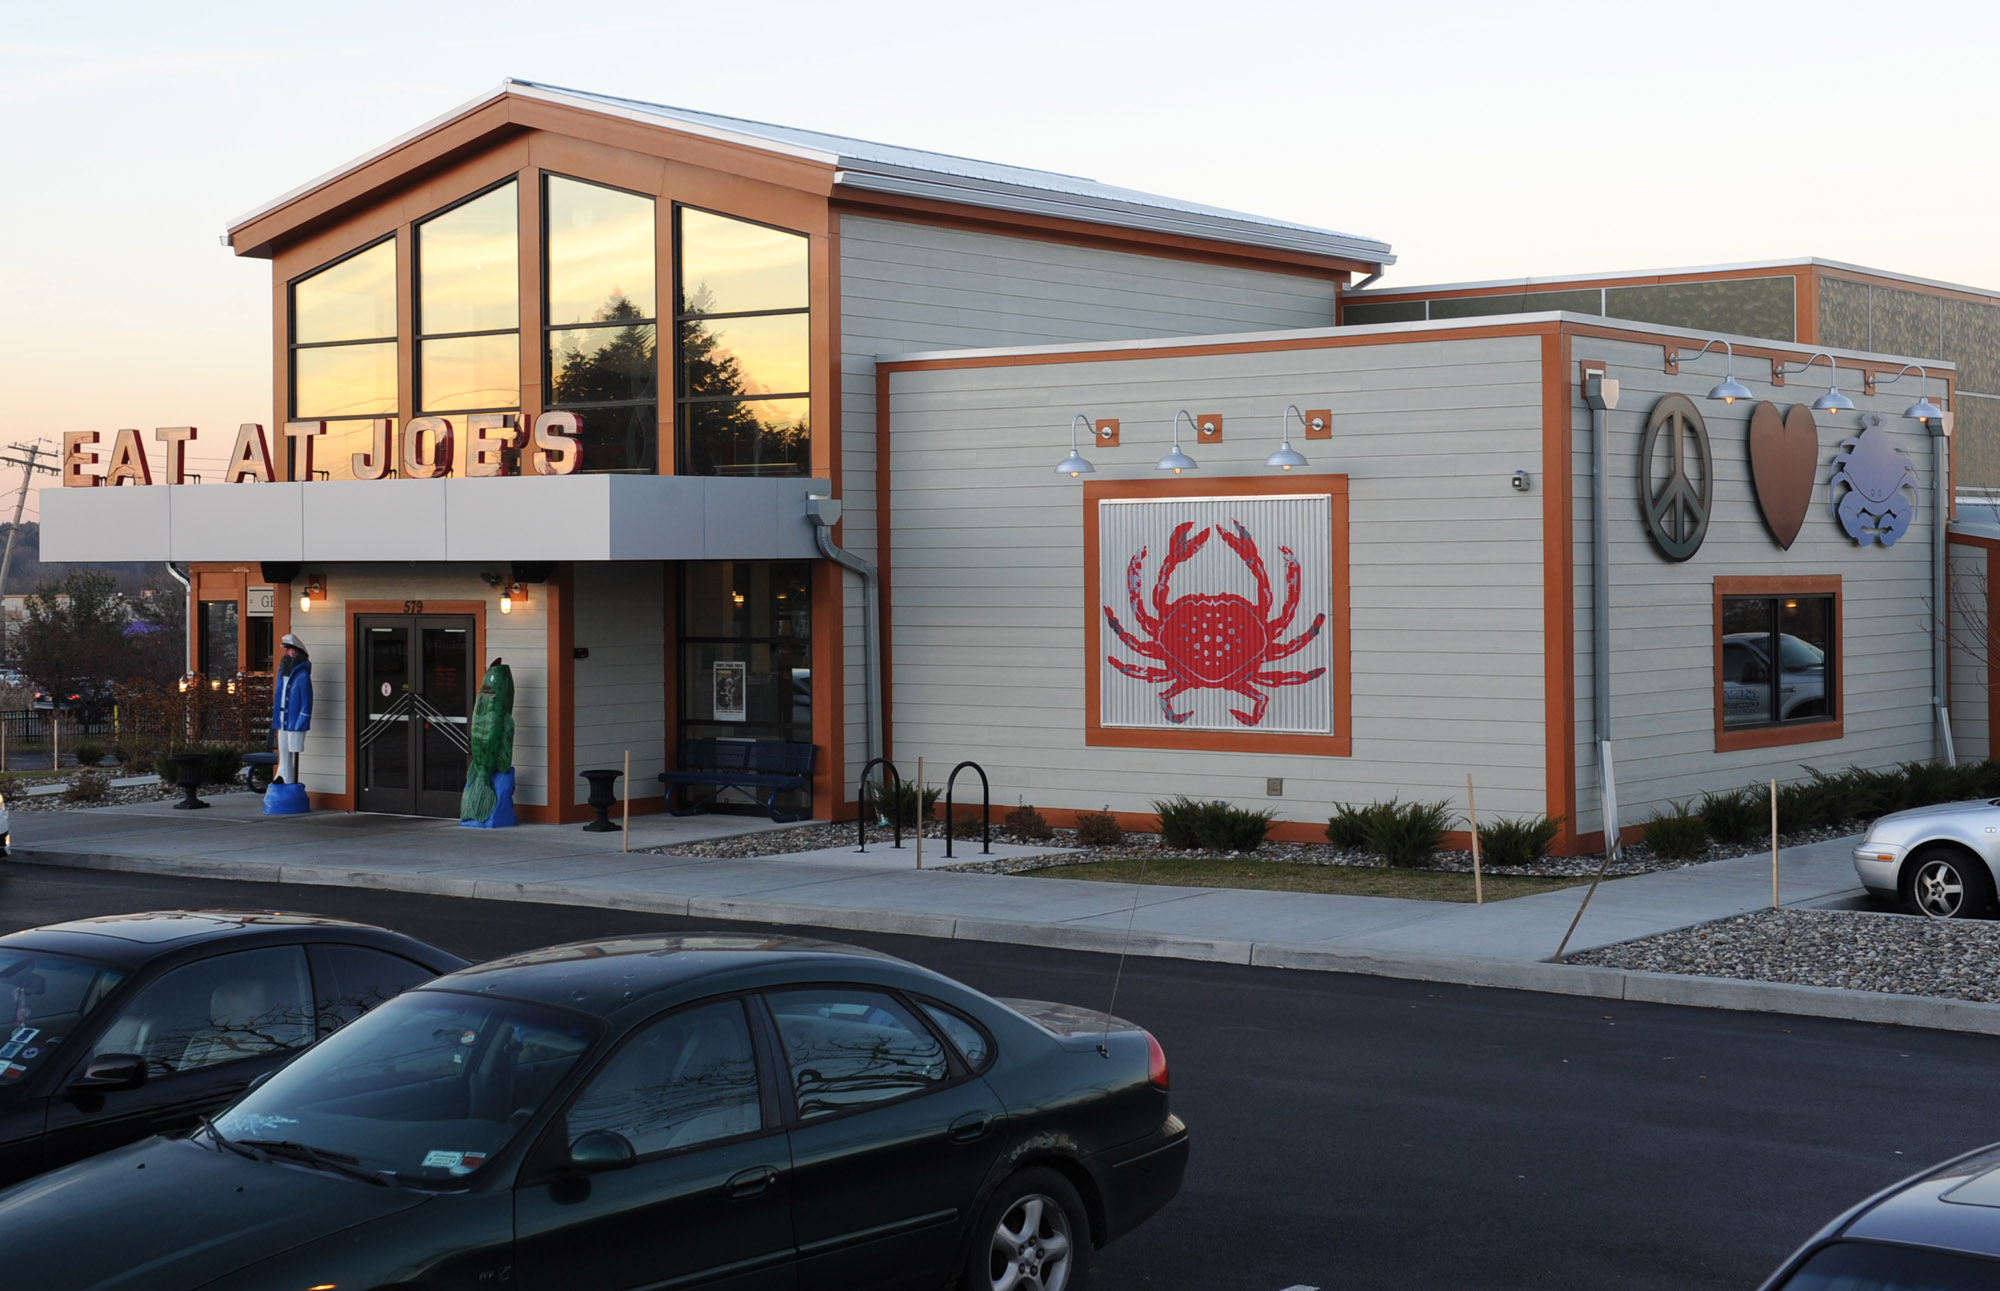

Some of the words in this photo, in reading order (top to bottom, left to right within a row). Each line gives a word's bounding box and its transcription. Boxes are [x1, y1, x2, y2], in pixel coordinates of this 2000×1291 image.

[63, 426, 197, 487] EAT
[225, 421, 327, 484] AT
[352, 411, 583, 480] JOE'S
[403, 600, 424, 614] 579
